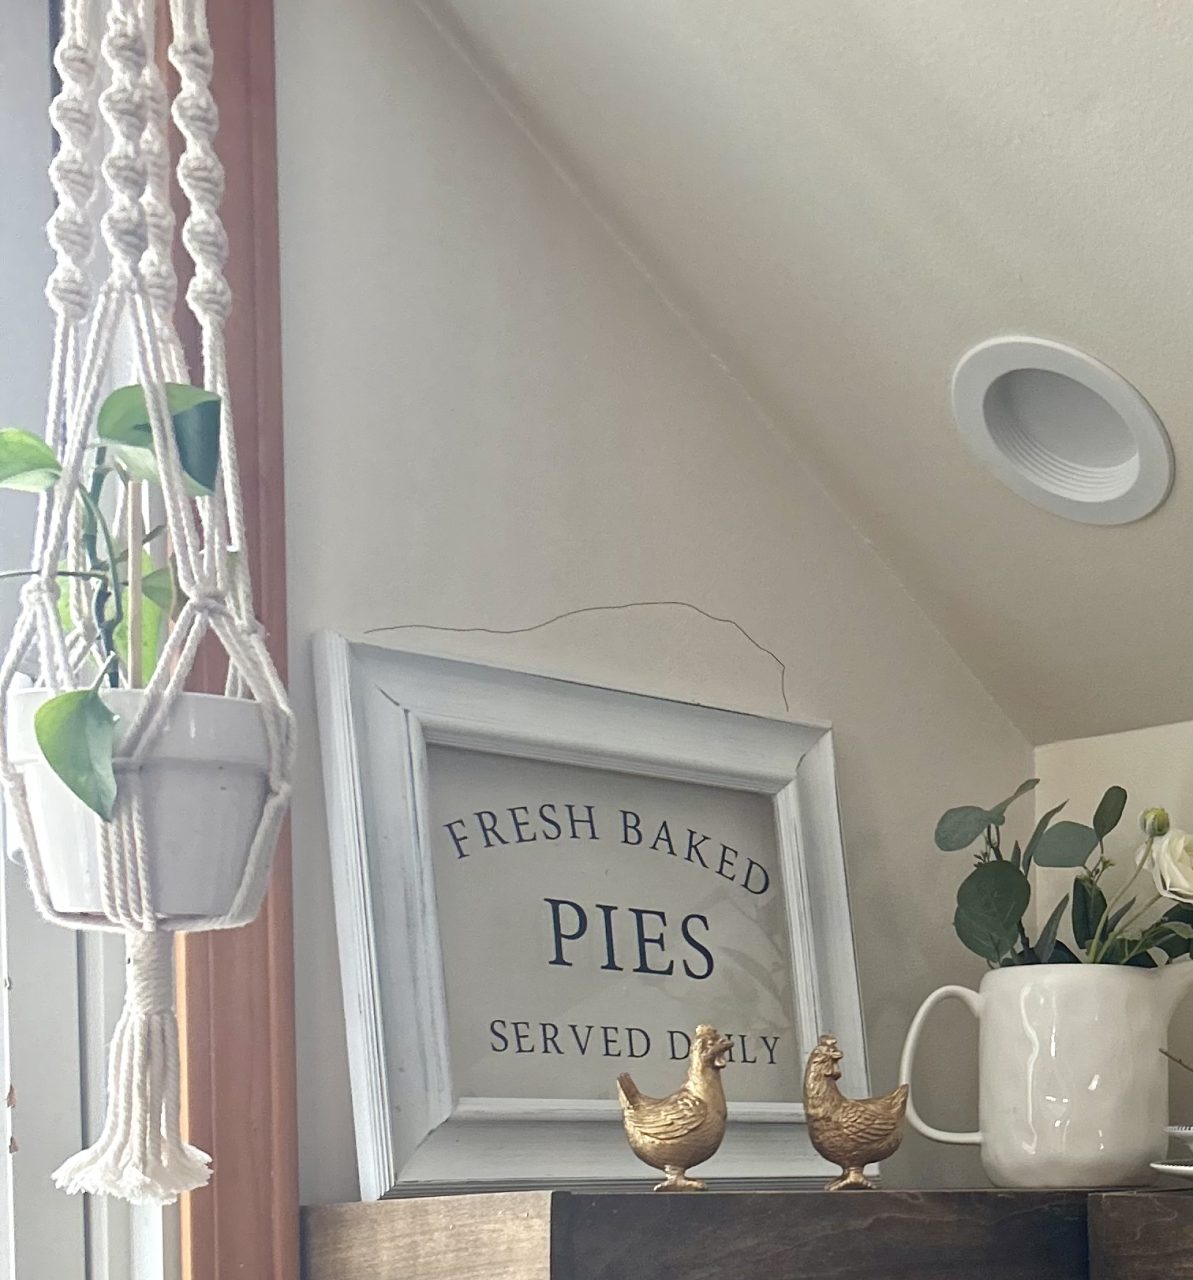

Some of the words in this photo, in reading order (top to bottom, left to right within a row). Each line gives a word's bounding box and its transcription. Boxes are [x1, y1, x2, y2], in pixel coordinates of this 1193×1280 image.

[443, 804, 600, 860] FRESH
[619, 810, 771, 895] BAKED
[544, 898, 714, 980] PIES
[490, 1019, 651, 1059] SERVED
[667, 1030, 781, 1065] DILY
